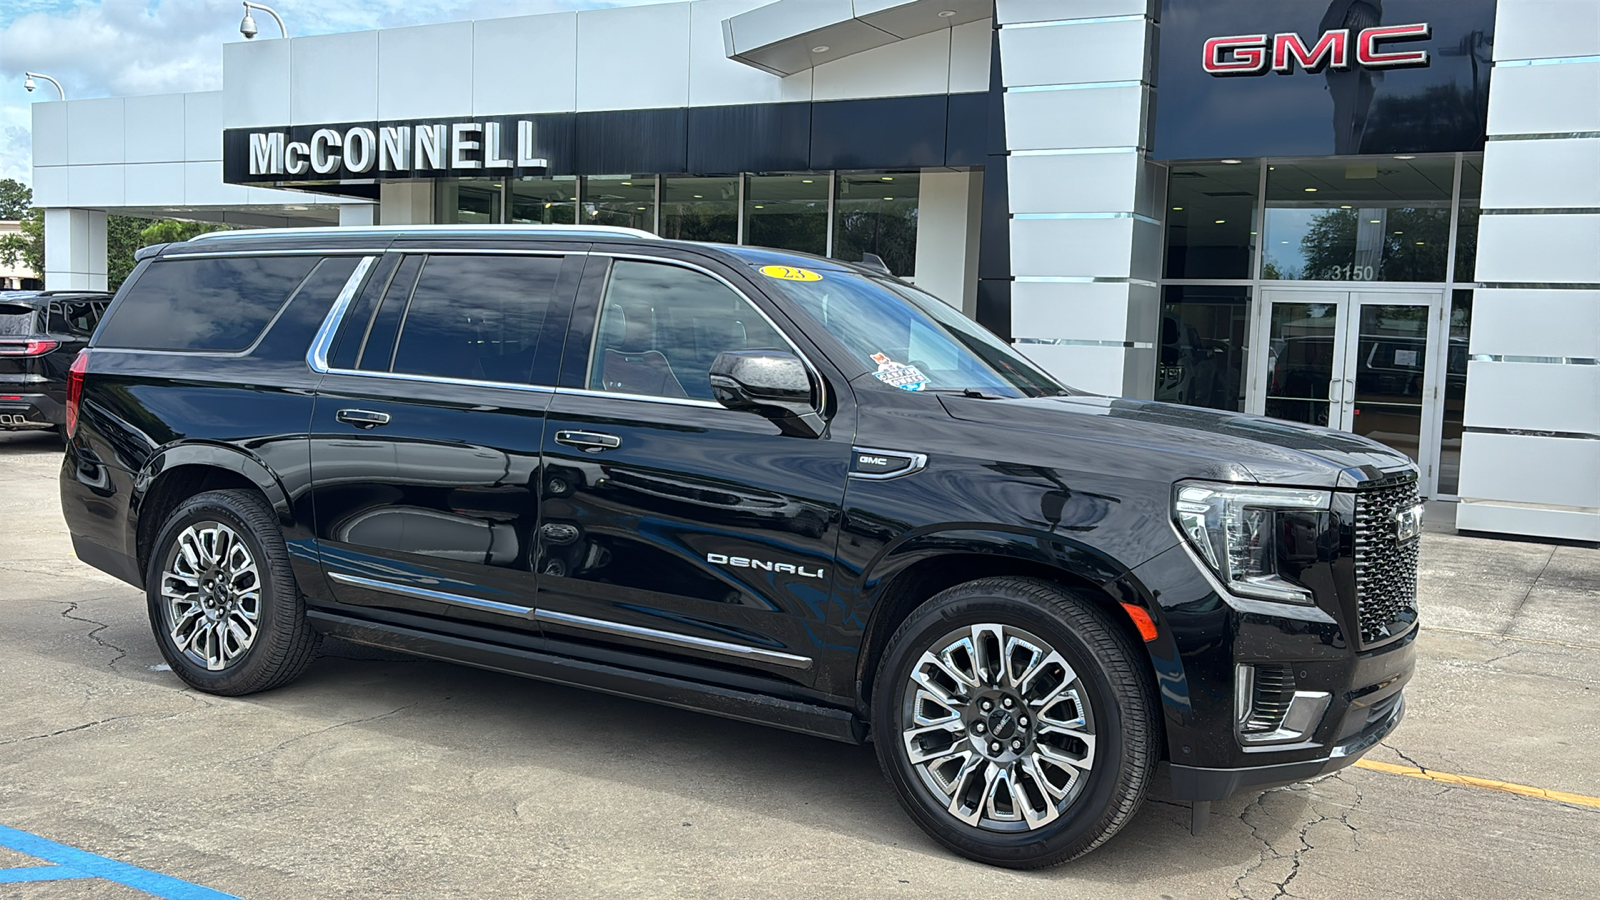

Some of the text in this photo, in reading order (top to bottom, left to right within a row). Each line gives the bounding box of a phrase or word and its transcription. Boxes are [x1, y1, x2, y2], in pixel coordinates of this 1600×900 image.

[1203, 22, 1430, 74] GMC
[249, 120, 547, 175] McCONNELL
[778, 267, 806, 279] 23
[1331, 265, 1373, 281] 3150
[859, 455, 888, 466] GMC
[707, 552, 824, 579] DENALI
